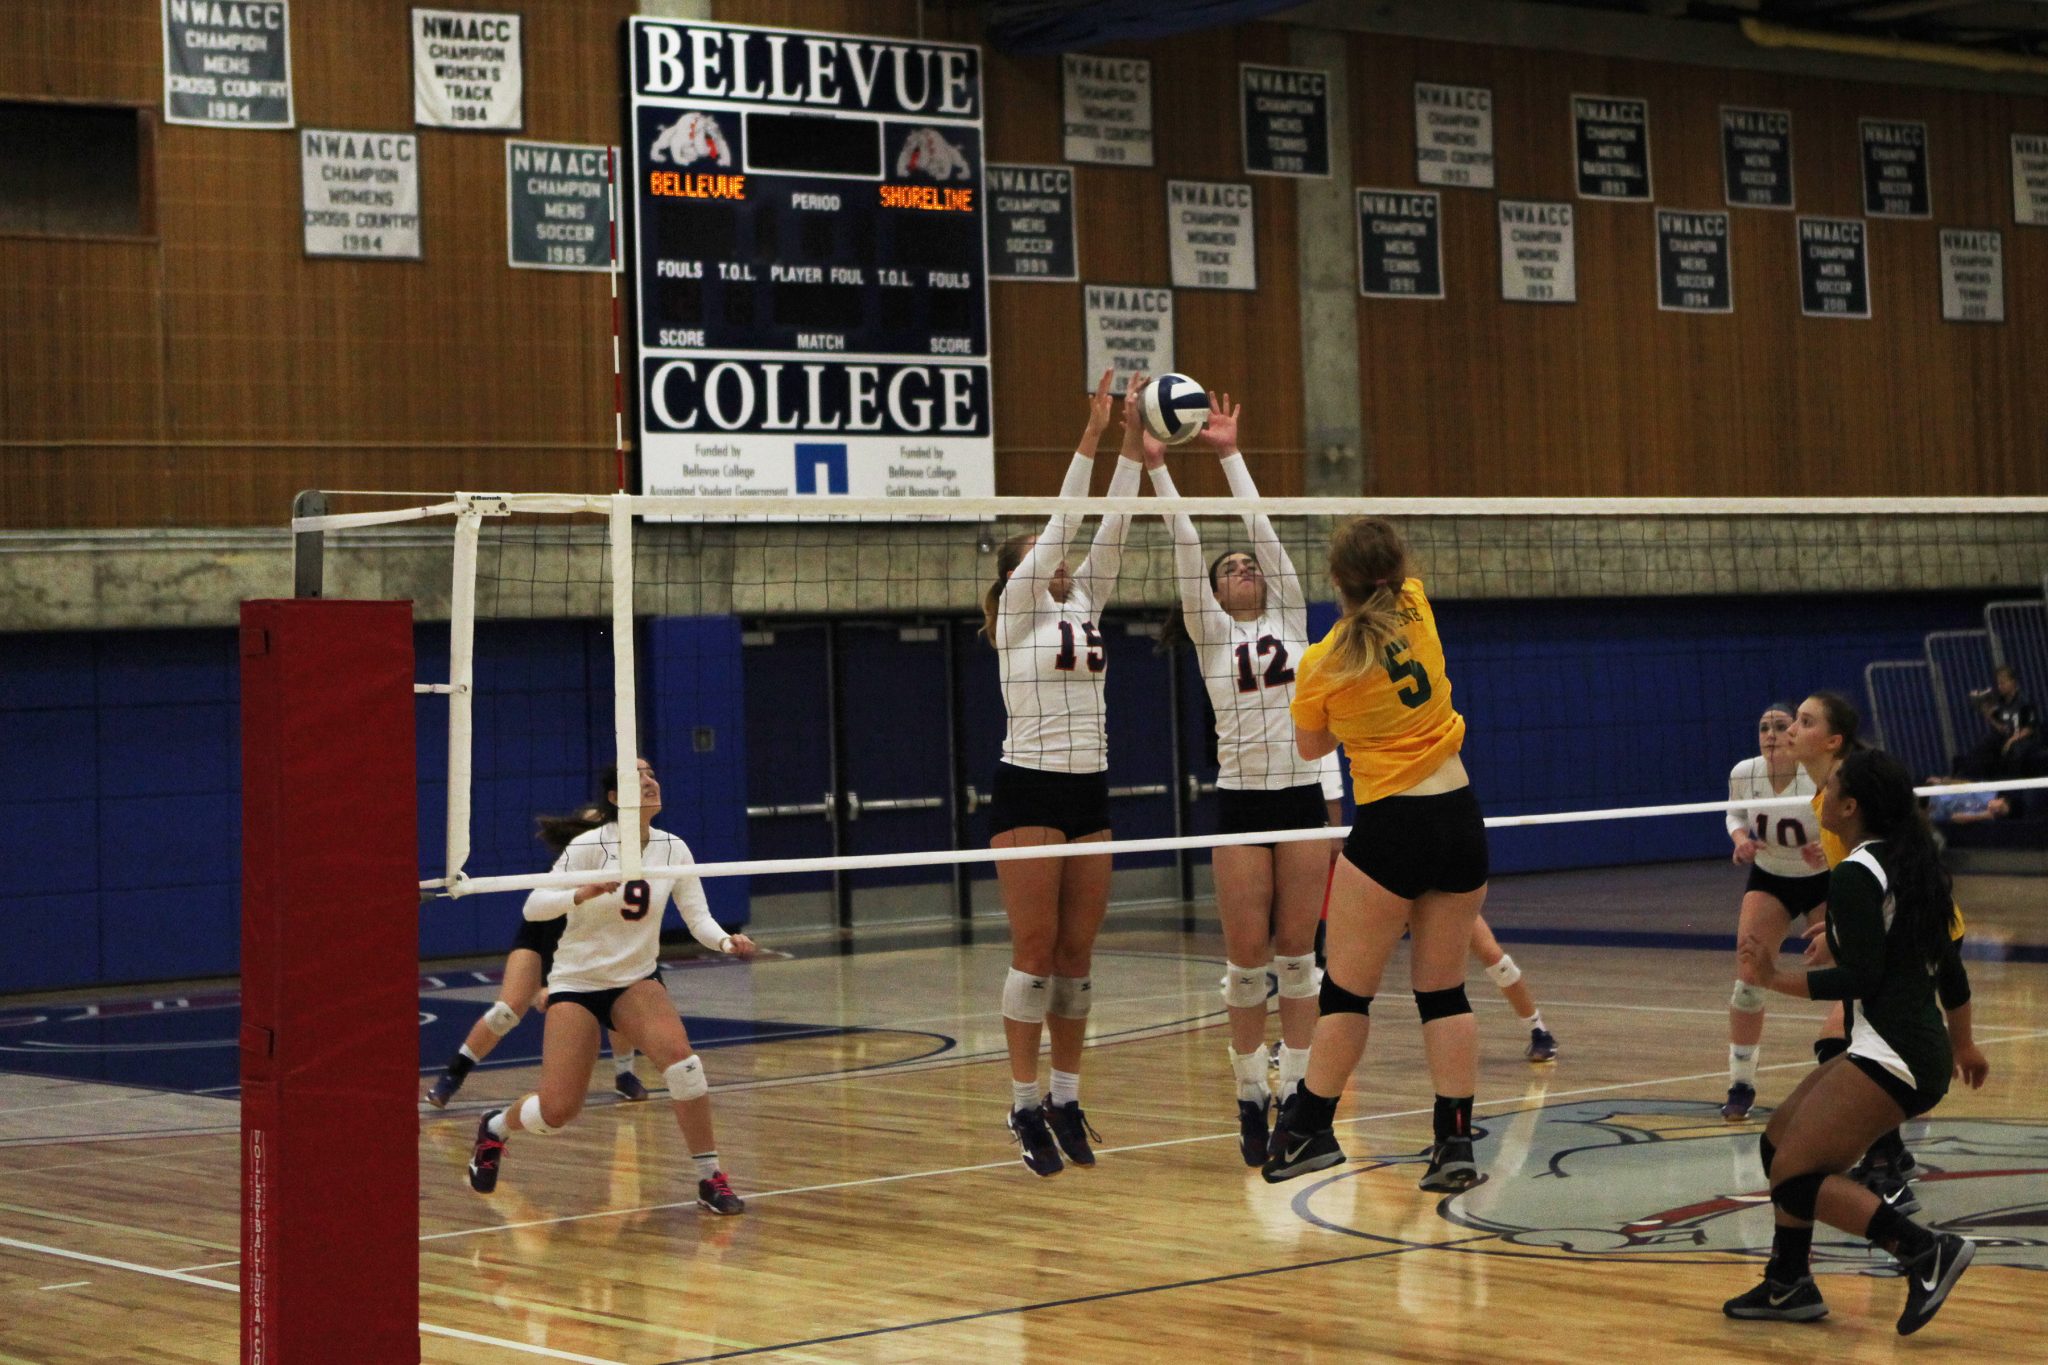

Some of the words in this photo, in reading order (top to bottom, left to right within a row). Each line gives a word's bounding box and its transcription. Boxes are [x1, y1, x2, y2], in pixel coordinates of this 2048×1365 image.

[172, 0, 279, 29] NWAACC
[423, 16, 511, 42] NWAACC
[185, 31, 268, 51] CHAMPION
[429, 44, 505, 62] CHAMPION
[204, 55, 249, 74] MENS
[643, 25, 973, 114] BELLEVUE
[169, 76, 217, 95] CROSS
[222, 79, 287, 98] COUNTRY
[445, 84, 493, 101] TRACK
[1247, 73, 1323, 96] NWAACC
[1256, 97, 1313, 115] CHAMPION
[1419, 87, 1489, 111] NWAACC
[208, 102, 250, 120] 1984
[452, 105, 488, 121] 1984
[1269, 117, 1303, 133] MENS
[1723, 112, 1787, 134] NWAACC
[307, 134, 412, 162] NWAACC
[514, 148, 609, 177] NWAACC
[321, 165, 399, 183] CHAMPION
[987, 171, 1067, 193] NWAACC
[527, 178, 601, 198] CHAMPION
[651, 171, 746, 200] BELLEVUE
[328, 189, 393, 207] WOMENS
[792, 193, 841, 211] PERIOD
[879, 185, 973, 211] SHORELINE
[997, 196, 1060, 213] CHAMPION
[1171, 186, 1248, 208] NWAACC
[1363, 194, 1434, 218] NWAACC
[304, 211, 350, 227] CROSS
[356, 212, 418, 229] COUNTRY
[545, 202, 586, 220] MENS
[1182, 210, 1239, 227] CHAMPION
[1503, 205, 1569, 226] NWAACC
[536, 222, 594, 242] SOCCER
[1011, 217, 1046, 233] MENS
[1372, 220, 1427, 237] CHAMPION
[1662, 215, 1725, 236] NWAACC
[1803, 222, 1860, 243] NWAACC
[342, 234, 383, 252] 1984
[1512, 228, 1562, 243] CHAMPION
[1943, 234, 1999, 253] NWAACC
[1006, 238, 1053, 254] SOCCER
[1385, 240, 1416, 255] MENS
[1669, 237, 1718, 254] CHAMPION
[1810, 244, 1855, 260] CHAMPION
[547, 246, 586, 264] 1985
[1196, 251, 1230, 266] TRACK
[1680, 256, 1708, 271] MENS
[657, 260, 703, 279] FOULS
[718, 263, 757, 281] T.O.L.
[771, 265, 822, 283] PLAYER
[831, 267, 865, 285] FOUL
[1821, 263, 1846, 277] MENS
[928, 272, 970, 289] FOULS
[1676, 273, 1715, 289] SOCCER
[1816, 280, 1852, 294] SOCCER
[1089, 289, 1168, 313] NWAACC
[1100, 316, 1159, 332] CHAMPION
[659, 330, 705, 347] SCORE
[797, 334, 844, 350] MATCH
[930, 338, 971, 354] SCORE
[1105, 337, 1155, 352] WOMENS
[1113, 357, 1149, 371] TRACK
[651, 361, 977, 432] COLLEGE
[695, 443, 729, 457] Funded
[731, 445, 742, 460] by
[900, 446, 931, 459] Funded
[682, 464, 720, 478] Bellevue
[723, 464, 756, 480] College
[888, 466, 924, 479] Bellevue
[926, 466, 957, 481] College
[1055, 620, 1107, 673] 15
[1235, 634, 1296, 693] 12
[1384, 637, 1432, 709] 5
[1755, 814, 1807, 849] 10
[620, 879, 651, 922] 9
